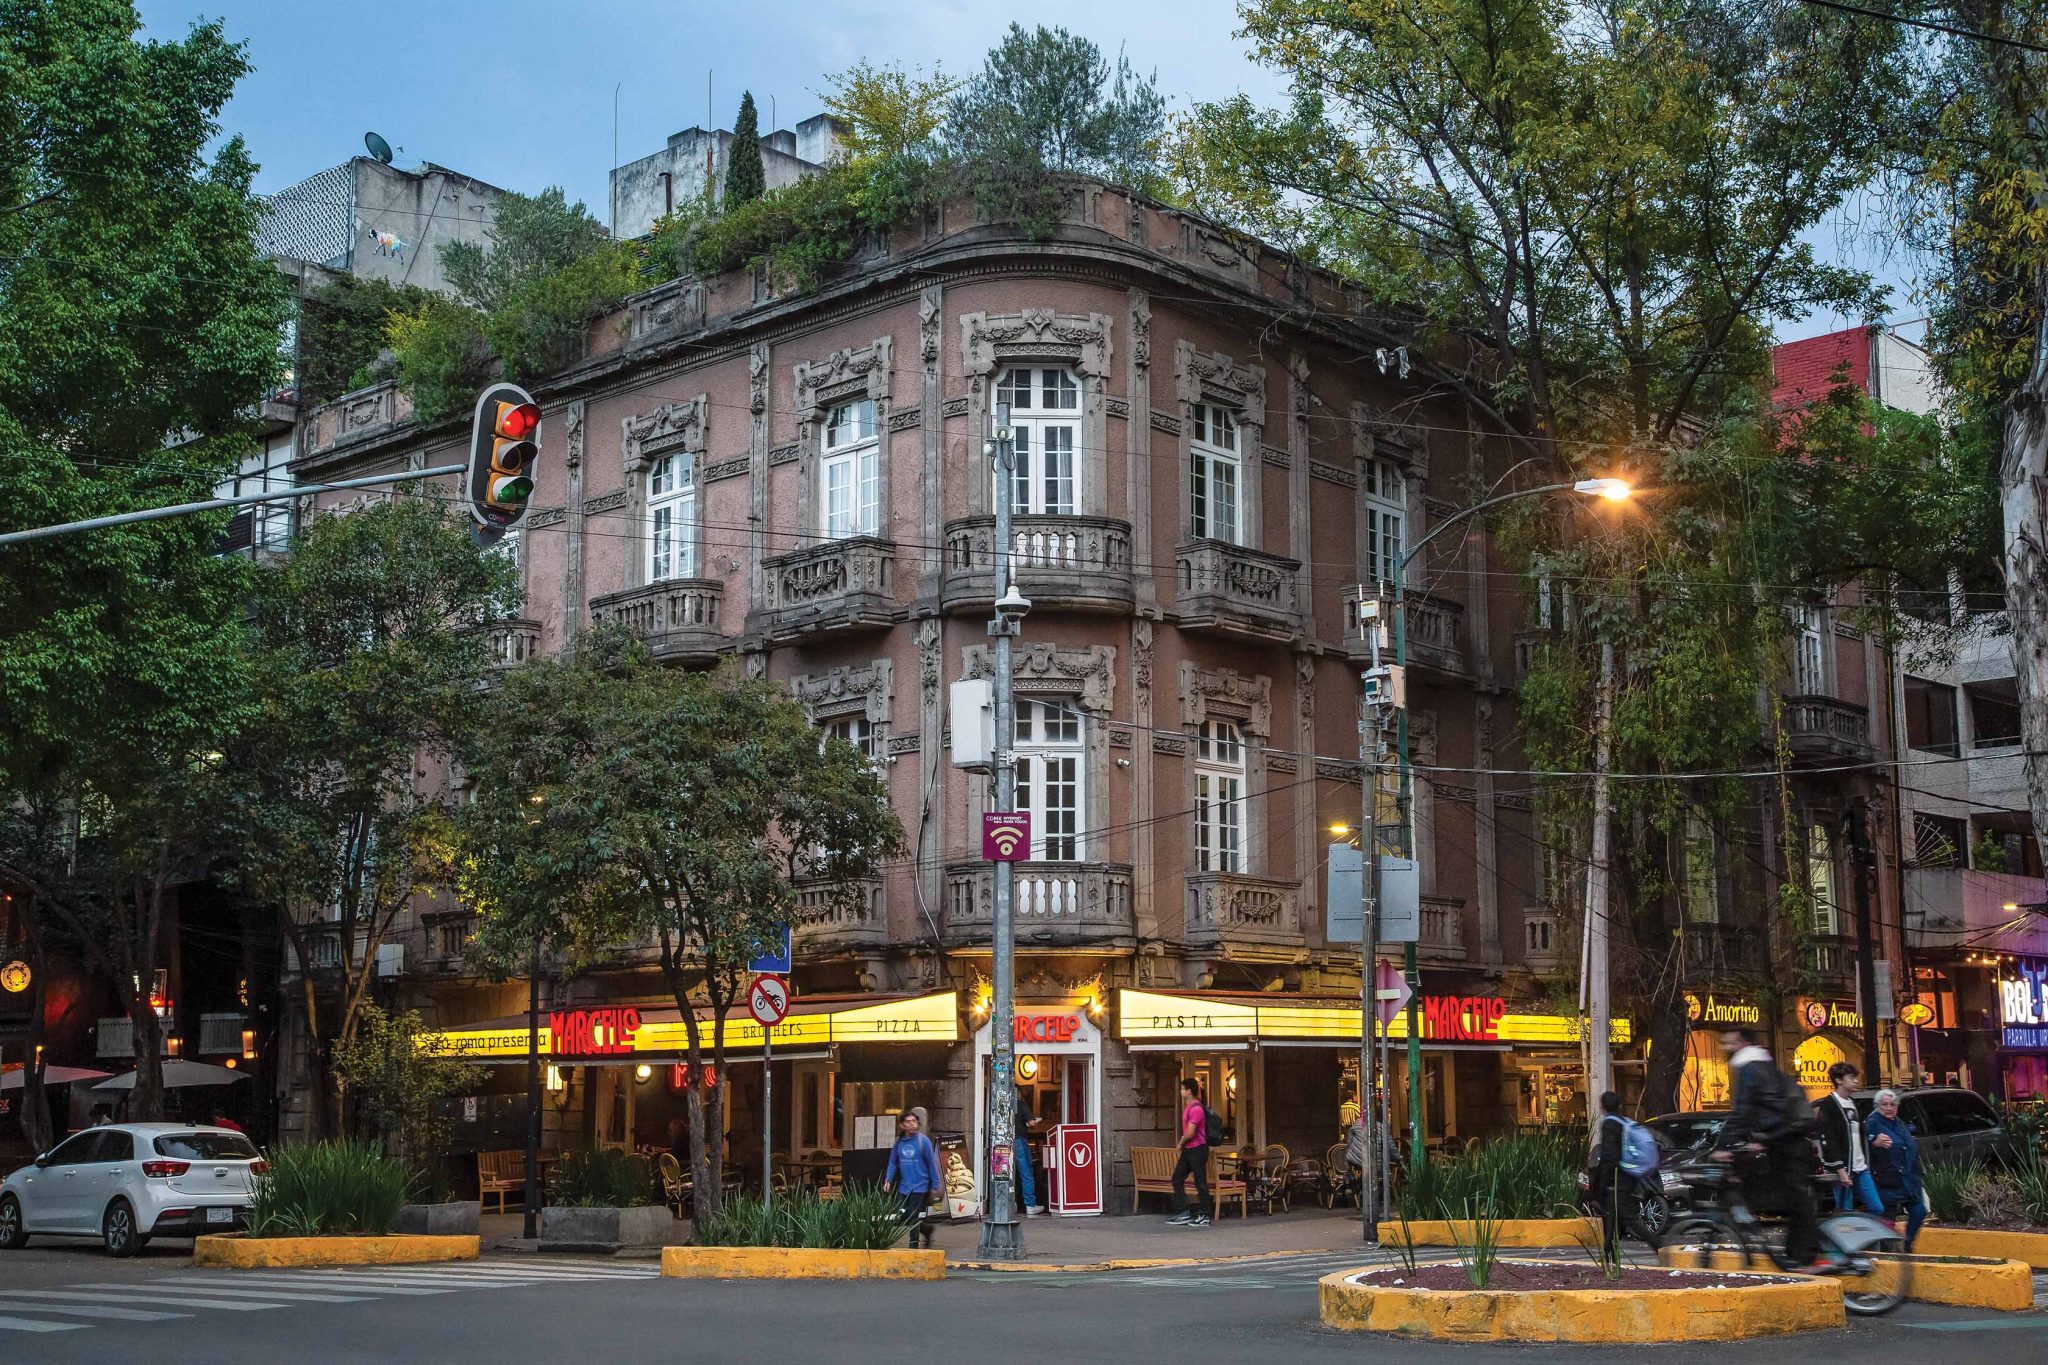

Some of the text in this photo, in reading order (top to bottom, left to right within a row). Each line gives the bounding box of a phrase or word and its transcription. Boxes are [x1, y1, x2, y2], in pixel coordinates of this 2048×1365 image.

[1424, 995, 1505, 1041] MARCELLO
[1704, 994, 1759, 1023] Amorino
[550, 1008, 641, 1055] MARCELLO
[876, 1019, 921, 1033] PIZZA
[1153, 1015, 1213, 1029] PASTA
[488, 1034, 547, 1052] presena
[2007, 1028, 2038, 1047] PARRILLA
